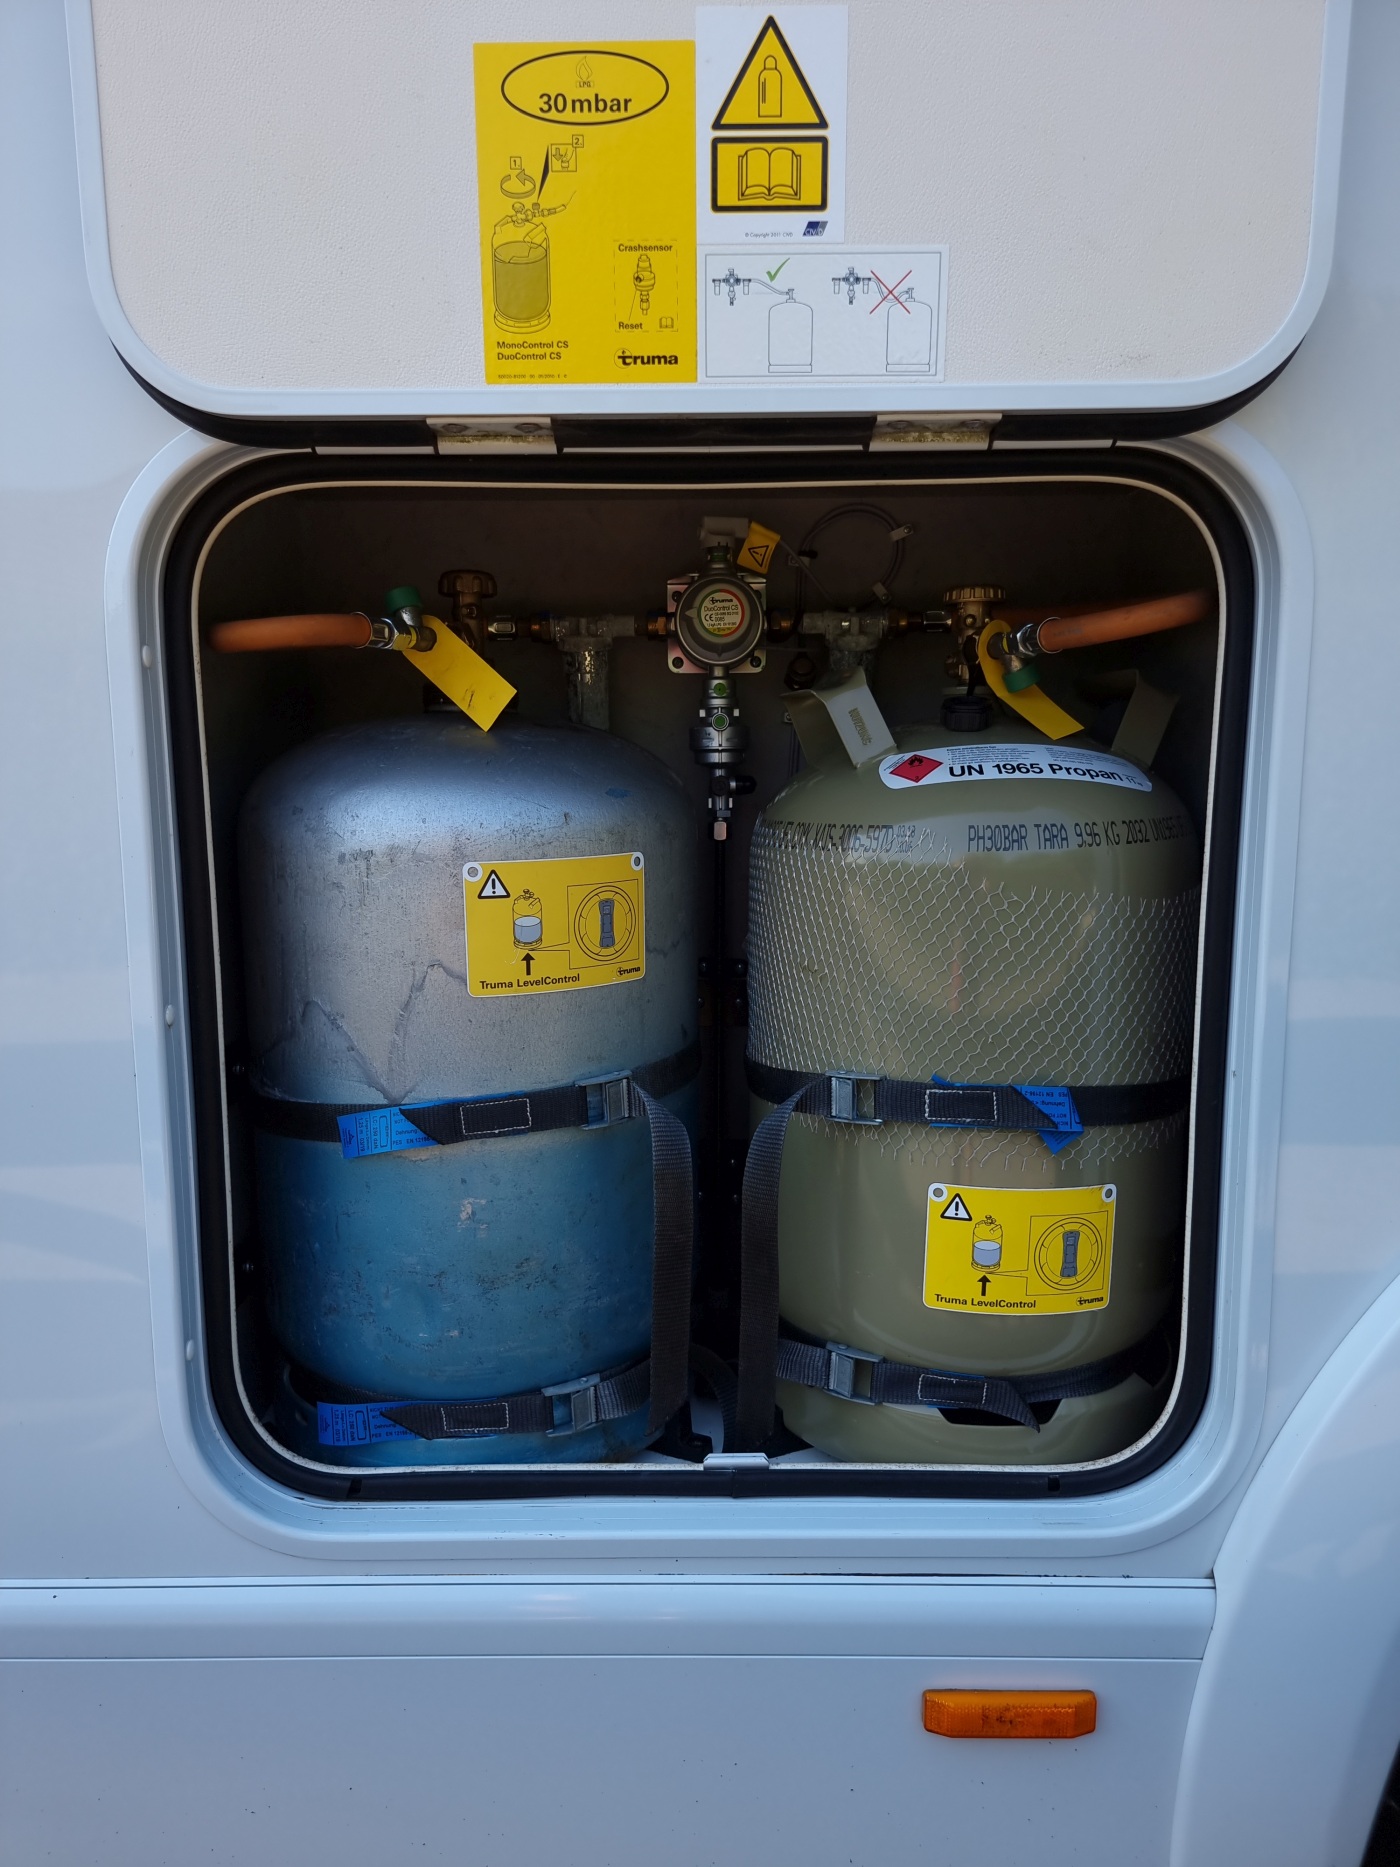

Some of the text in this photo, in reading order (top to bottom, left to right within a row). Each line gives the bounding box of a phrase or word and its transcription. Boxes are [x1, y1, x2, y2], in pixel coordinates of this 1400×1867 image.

[538, 93, 632, 114] 30 mbar
[617, 244, 673, 253] Crashsensor
[618, 321, 643, 330] Reset
[496, 340, 569, 350] MonoControl CS
[496, 352, 562, 361] DuoControl CS
[616, 349, 679, 366] truma
[709, 597, 733, 605] truma
[948, 763, 985, 779] UN
[992, 762, 1044, 776] 1965
[1050, 763, 1123, 782] Propan
[967, 824, 1029, 853] PH30BAR
[1034, 823, 1069, 850] TARA
[1103, 820, 1121, 846] KG
[1121, 819, 1151, 844] 2032
[616, 966, 641, 977] truma
[479, 973, 580, 990] Truma LevelControl
[934, 1293, 1037, 1309] Truma LevelControl
[1077, 1295, 1104, 1306] truma
